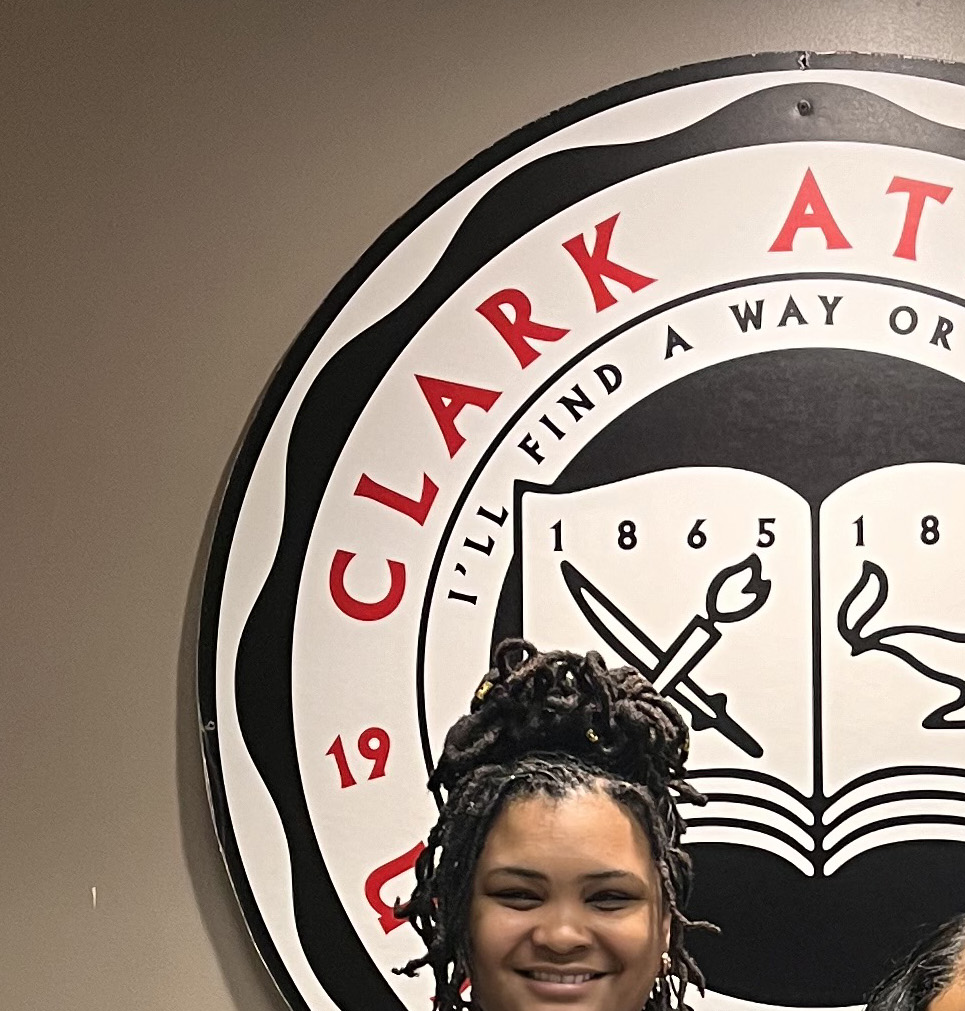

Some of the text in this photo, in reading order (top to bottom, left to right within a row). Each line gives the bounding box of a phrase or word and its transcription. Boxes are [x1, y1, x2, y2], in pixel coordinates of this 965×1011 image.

[329, 211, 658, 621] CLARK
[447, 505, 508, 605] I'LL
[518, 364, 623, 464] FIND
[664, 325, 694, 360] A
[728, 294, 843, 333] WAY
[888, 305, 954, 350] OR
[325, 726, 391, 788] 19
